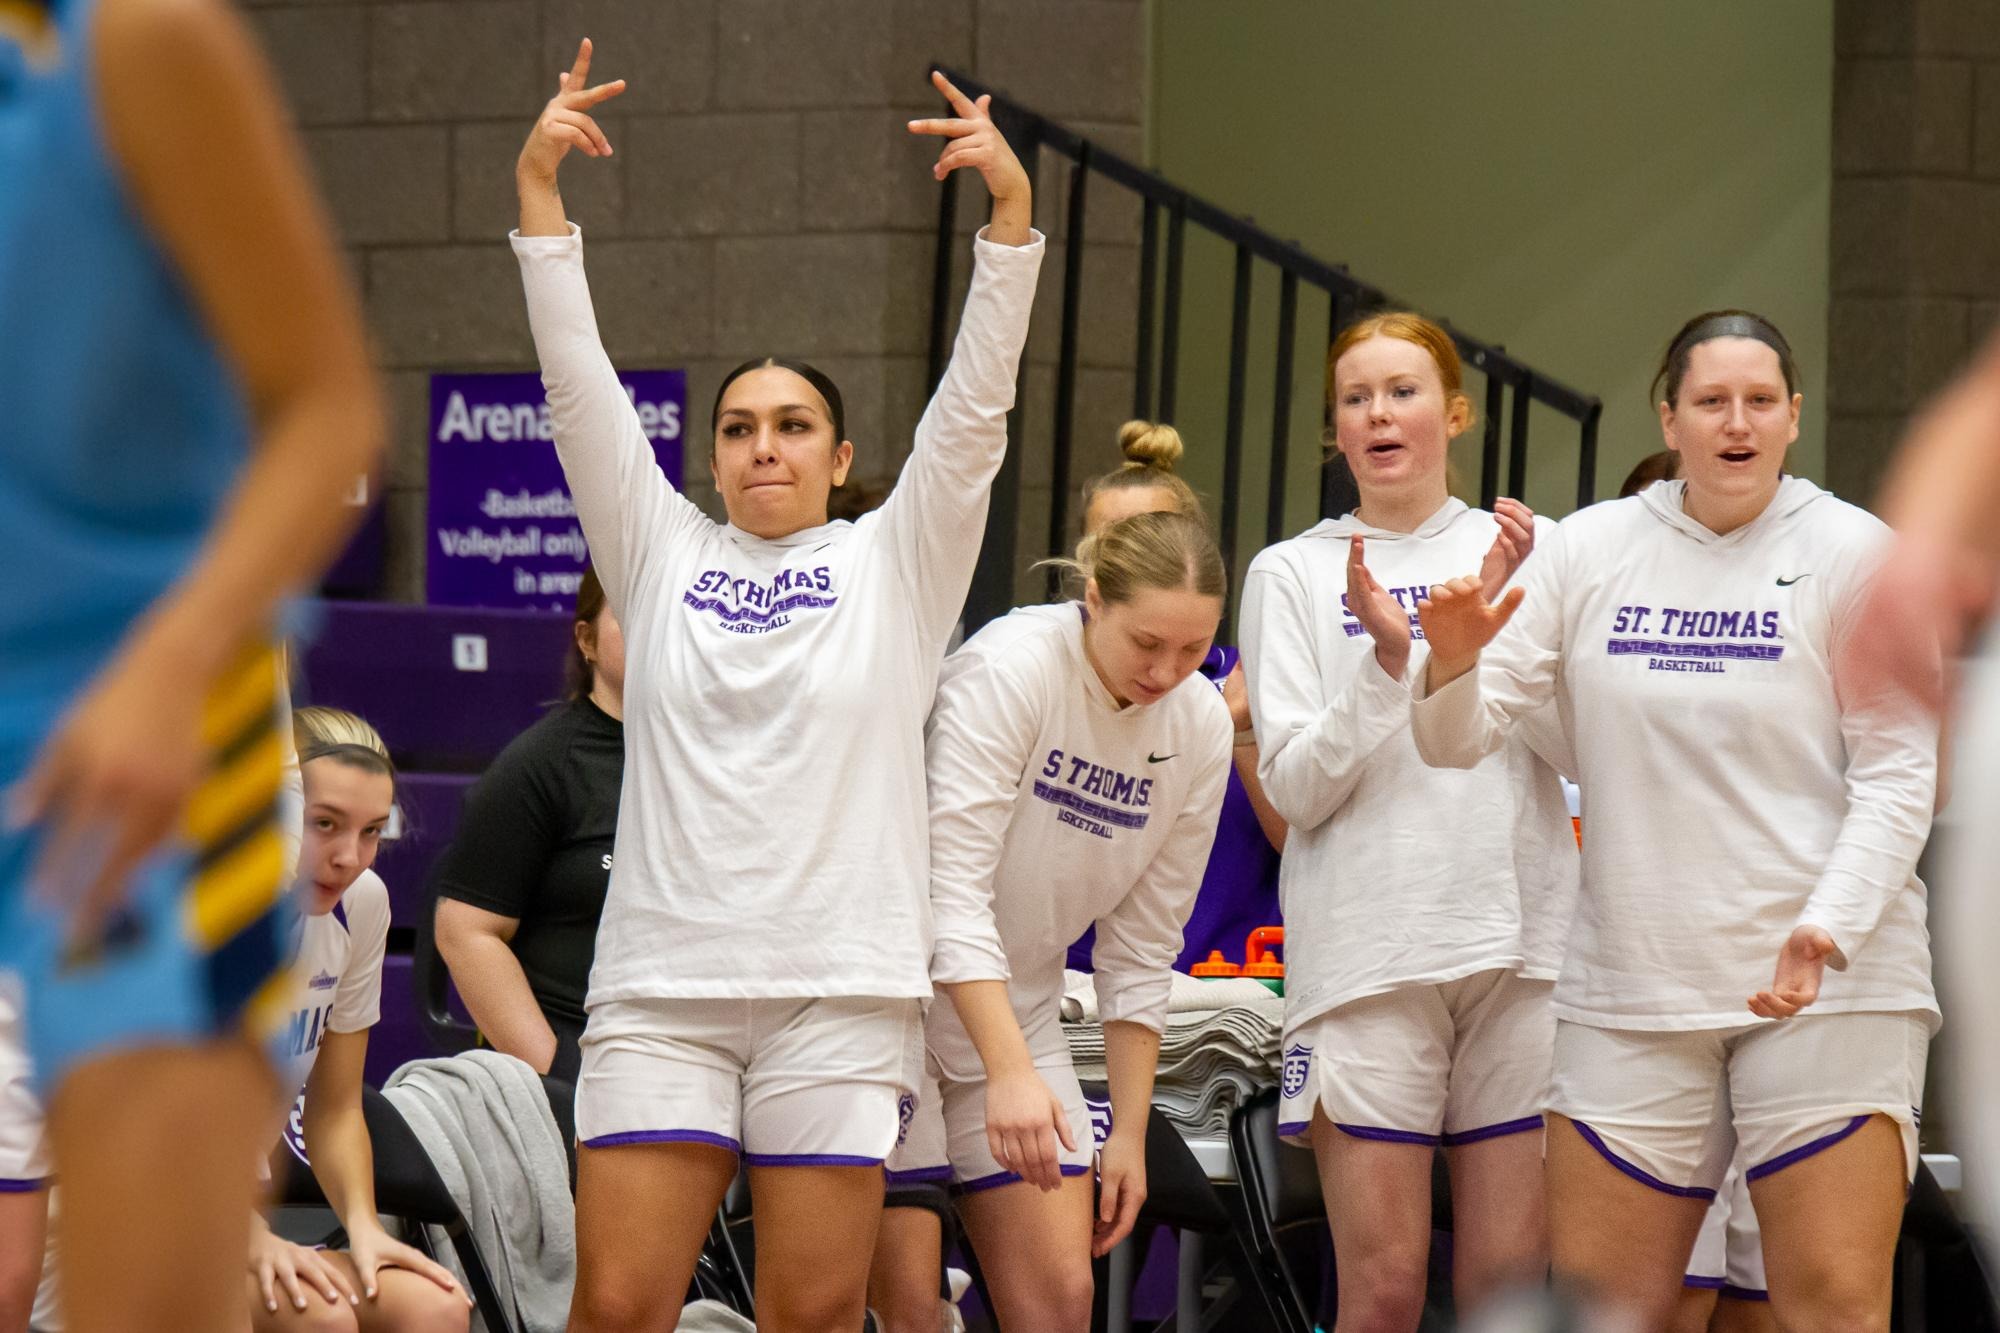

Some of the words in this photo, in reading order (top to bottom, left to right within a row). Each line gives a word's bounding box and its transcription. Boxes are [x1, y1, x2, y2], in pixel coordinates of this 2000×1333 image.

[438, 526, 541, 564] Volleyball
[542, 526, 587, 563] only
[513, 566, 537, 594] in
[732, 566, 831, 608] THMAS
[1613, 606, 1651, 634] ST.
[1661, 608, 1779, 639] THOMAS
[1648, 658, 1726, 673] BASKETBALL
